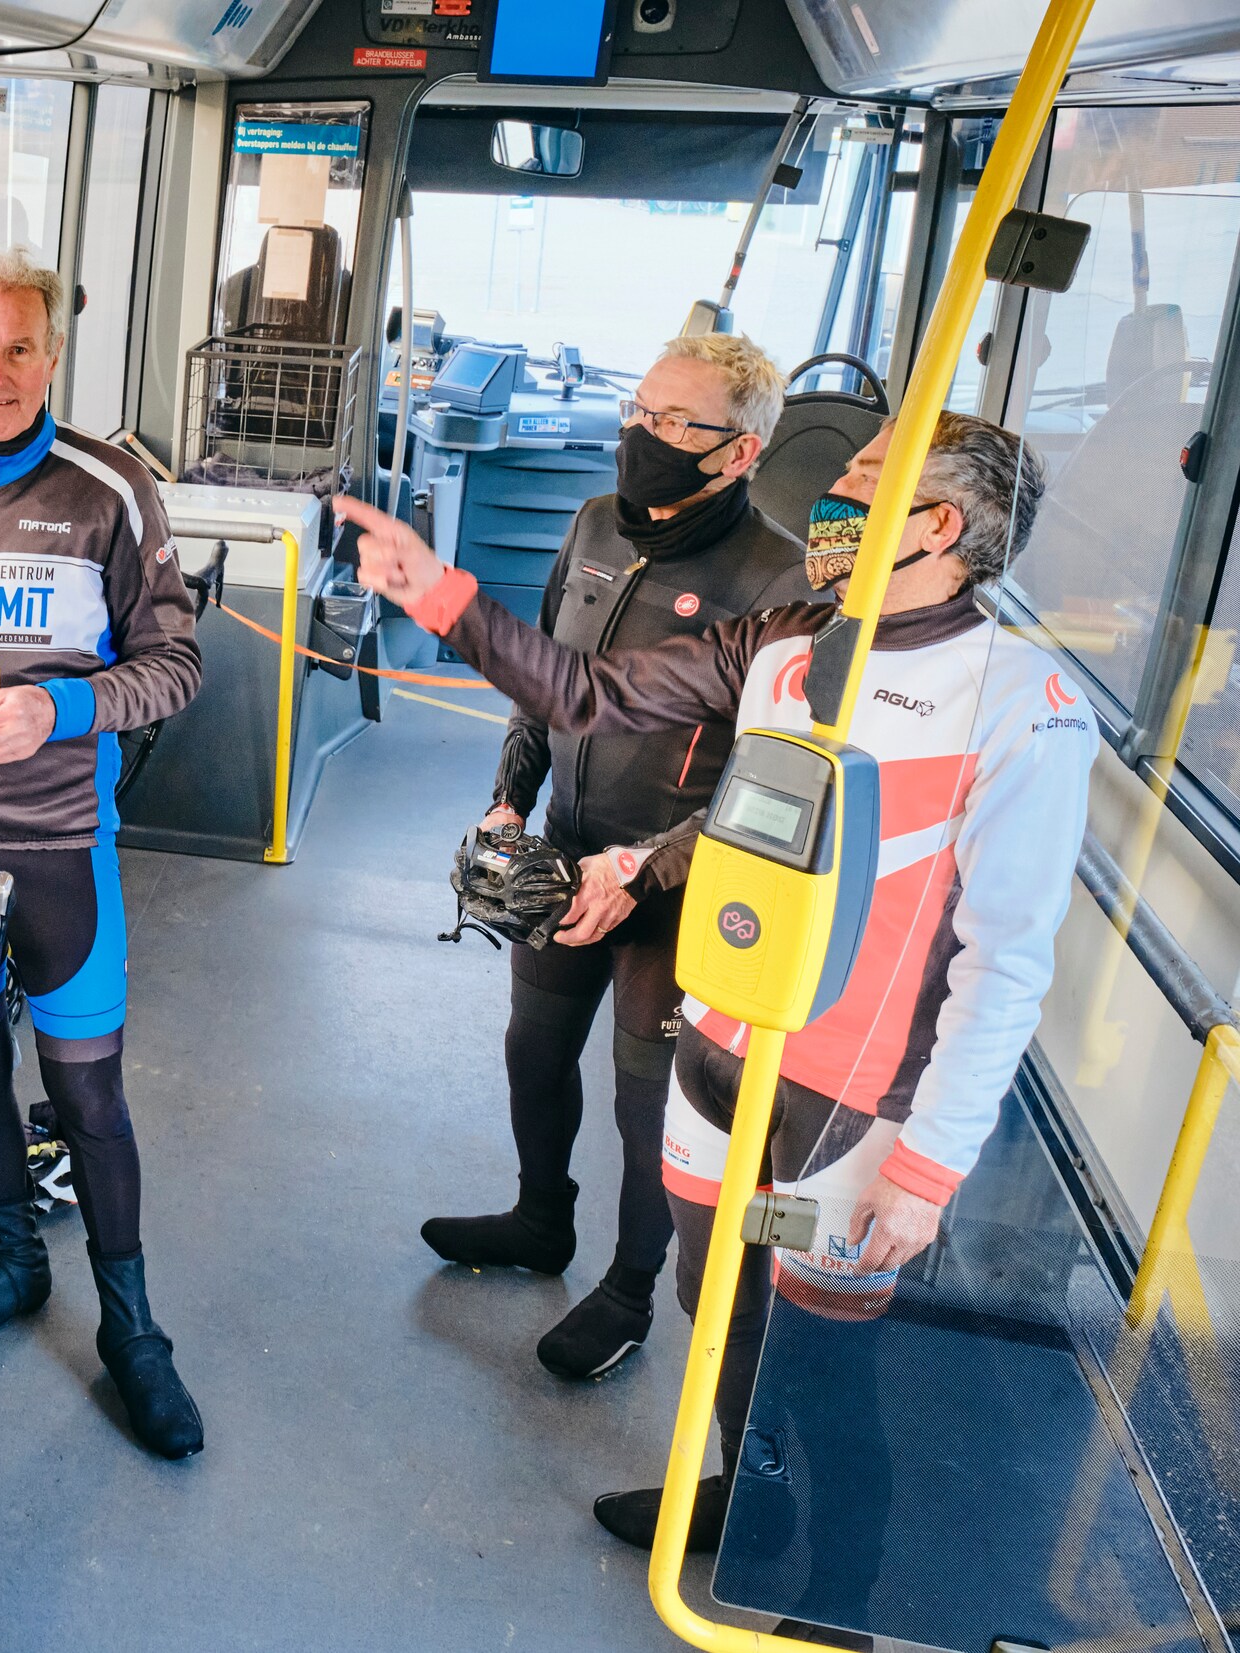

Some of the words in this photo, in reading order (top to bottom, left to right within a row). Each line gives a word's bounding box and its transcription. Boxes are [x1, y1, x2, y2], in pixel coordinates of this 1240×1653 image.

[365, 50, 415, 59] BRANDBLUSSER
[356, 58, 381, 66] ACHTER
[384, 59, 422, 67] CHAUFFEUR
[237, 126, 246, 136] Bij
[247, 128, 283, 138] vertraging:
[237, 139, 280, 150] Overstappers
[281, 141, 306, 149] melden
[307, 142, 316, 152] bij
[317, 142, 326, 150] de
[873, 689, 919, 710] AGU
[665, 1135, 691, 1158] BERG
